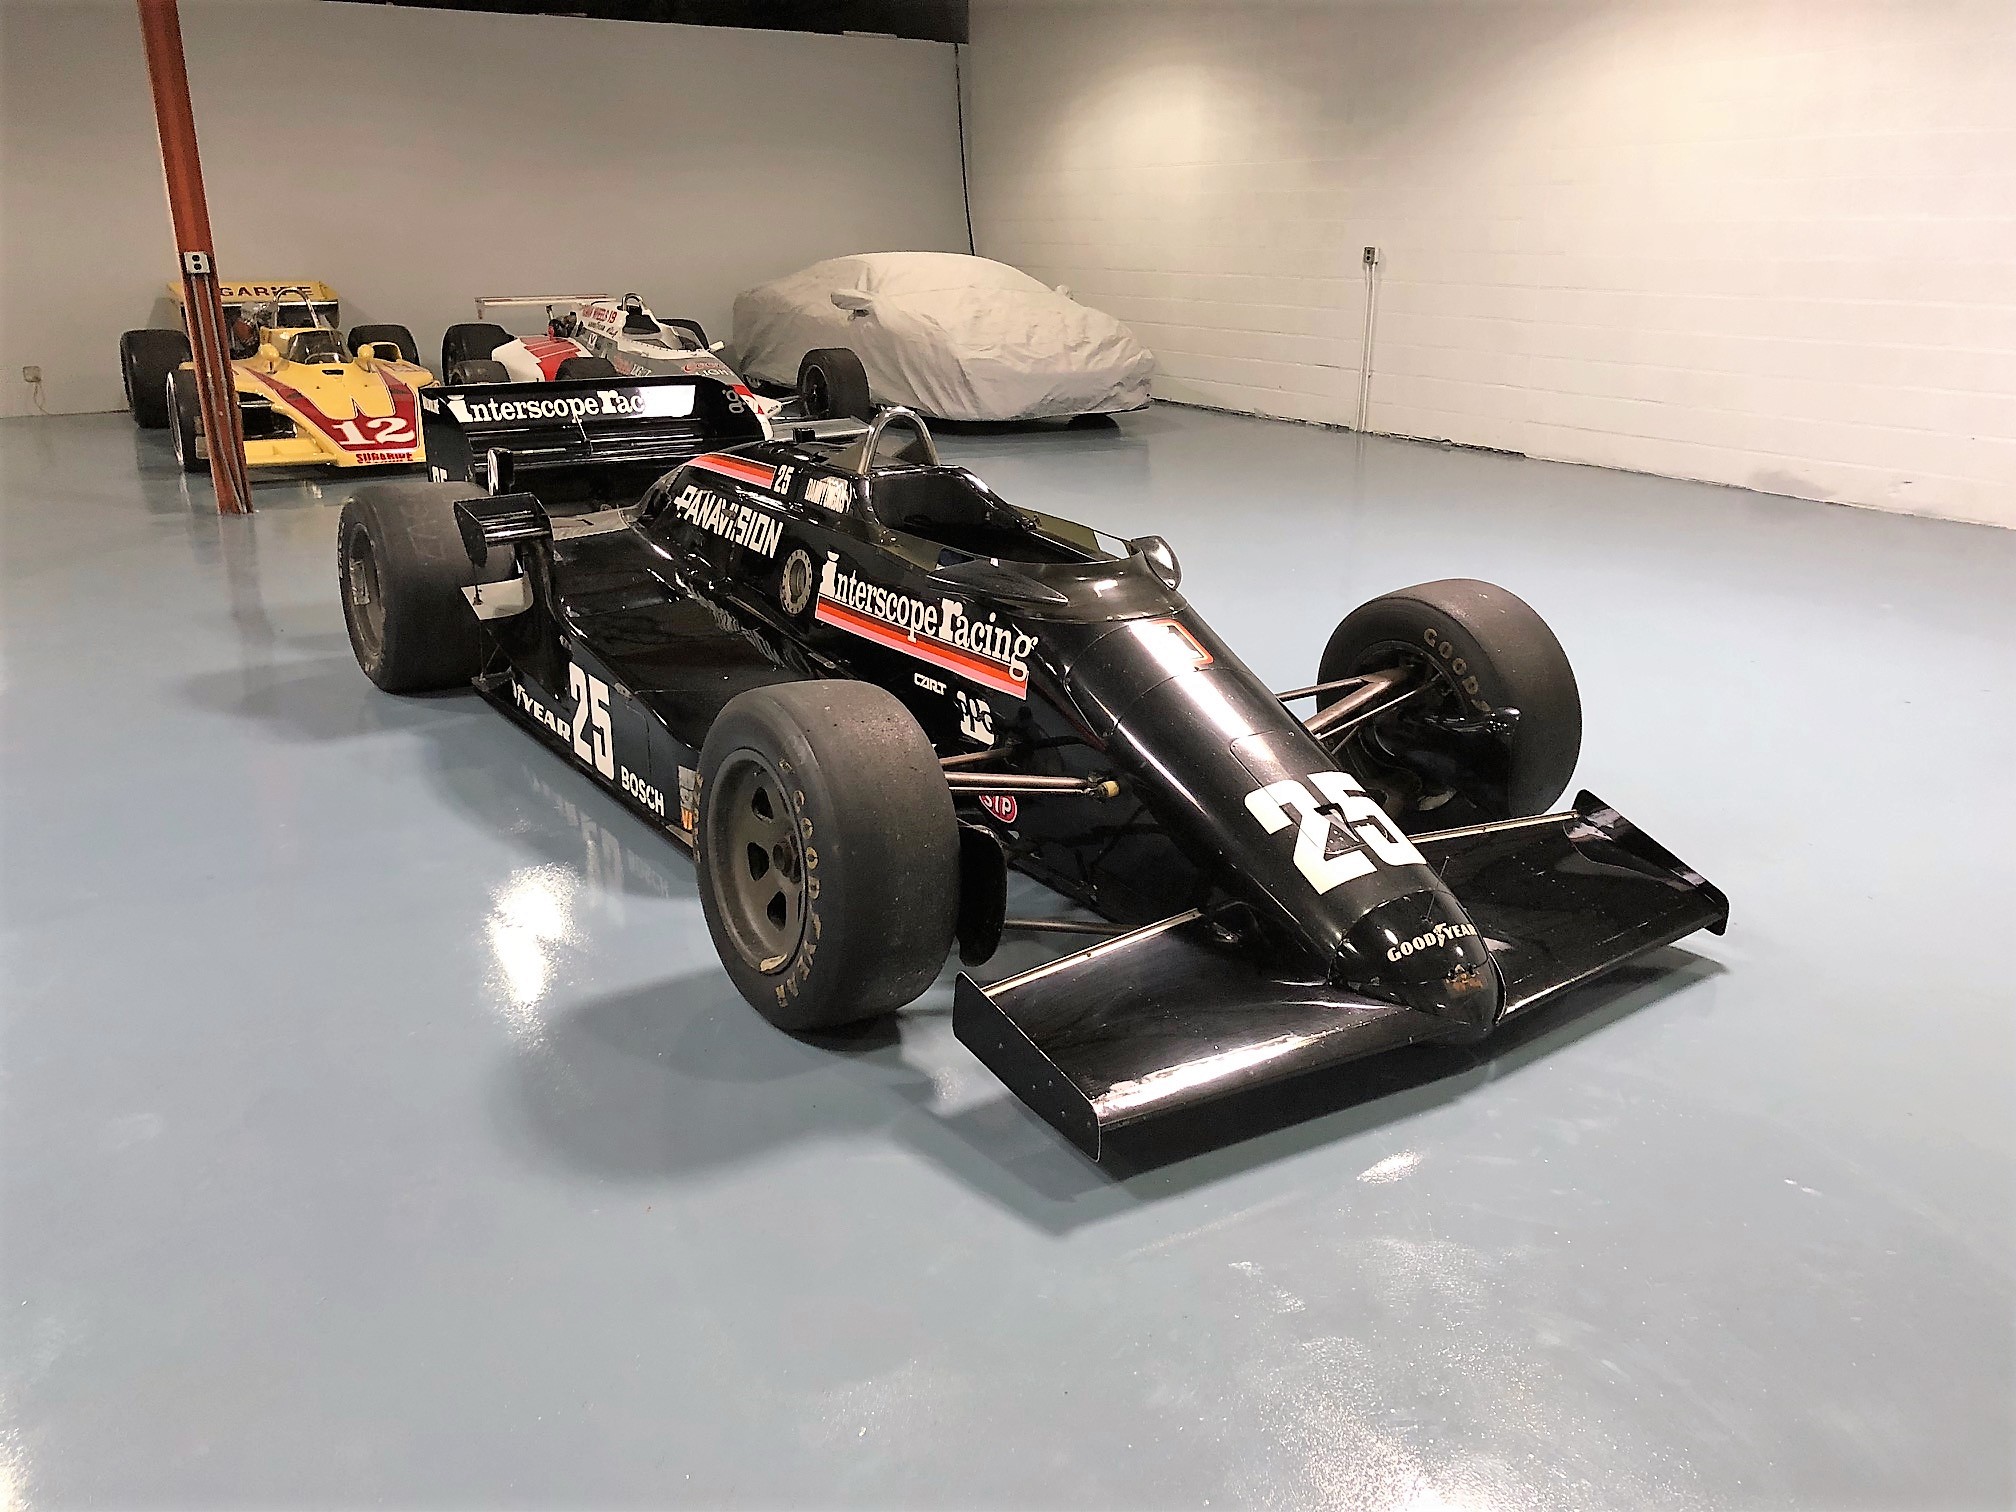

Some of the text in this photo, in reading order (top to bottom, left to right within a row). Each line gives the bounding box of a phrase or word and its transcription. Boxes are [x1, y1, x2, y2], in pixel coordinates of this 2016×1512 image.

[332, 417, 415, 445] 12
[773, 464, 794, 495] 25
[673, 485, 784, 559] PANAVISION
[914, 672, 947, 696] CART
[512, 680, 571, 742] YEAR
[568, 661, 615, 781] 25
[620, 764, 665, 817] BOSCH
[1244, 770, 1428, 896] 25
[1387, 922, 1478, 962] GOODYEAR
